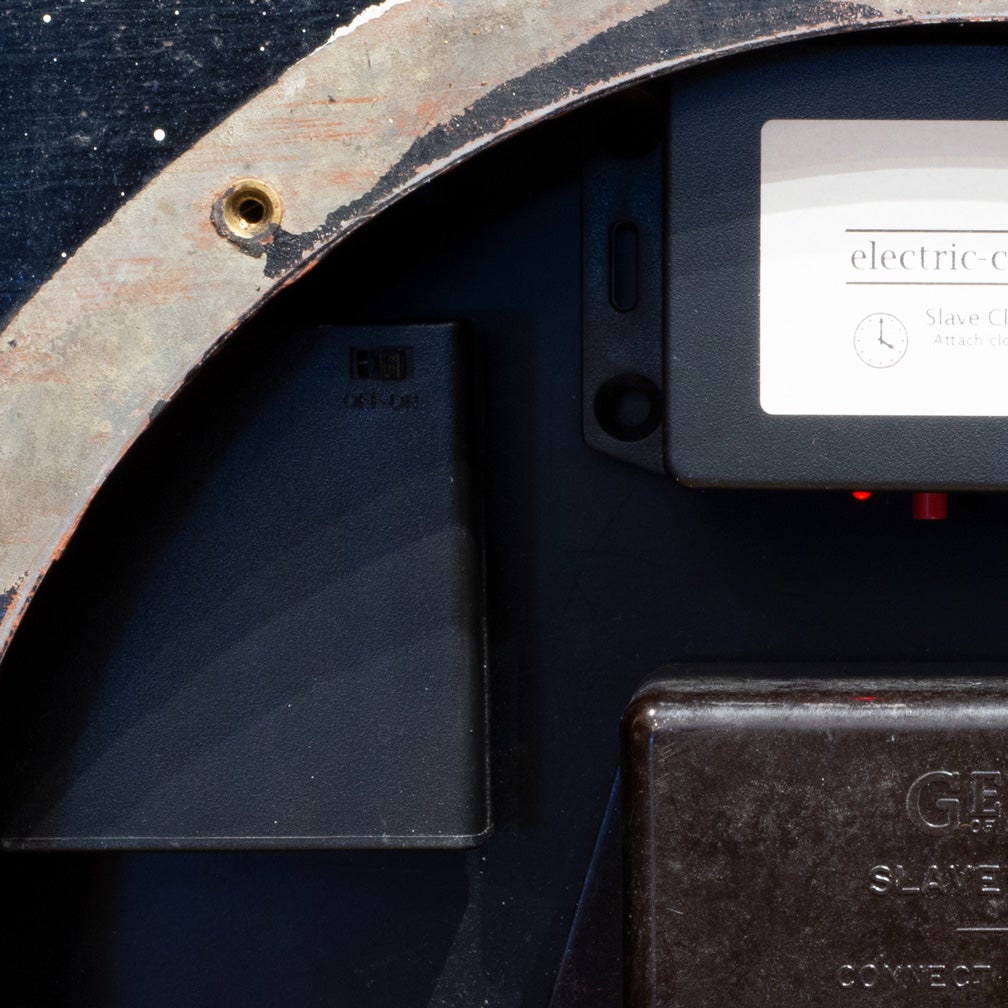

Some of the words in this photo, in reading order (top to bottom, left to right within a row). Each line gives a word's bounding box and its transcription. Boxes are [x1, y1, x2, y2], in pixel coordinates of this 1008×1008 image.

[925, 308, 980, 327] Slave
[933, 333, 983, 347] Attach
[969, 818, 996, 833] OF
[869, 864, 1001, 896] SLAVE
[838, 962, 993, 987] CONNECT
